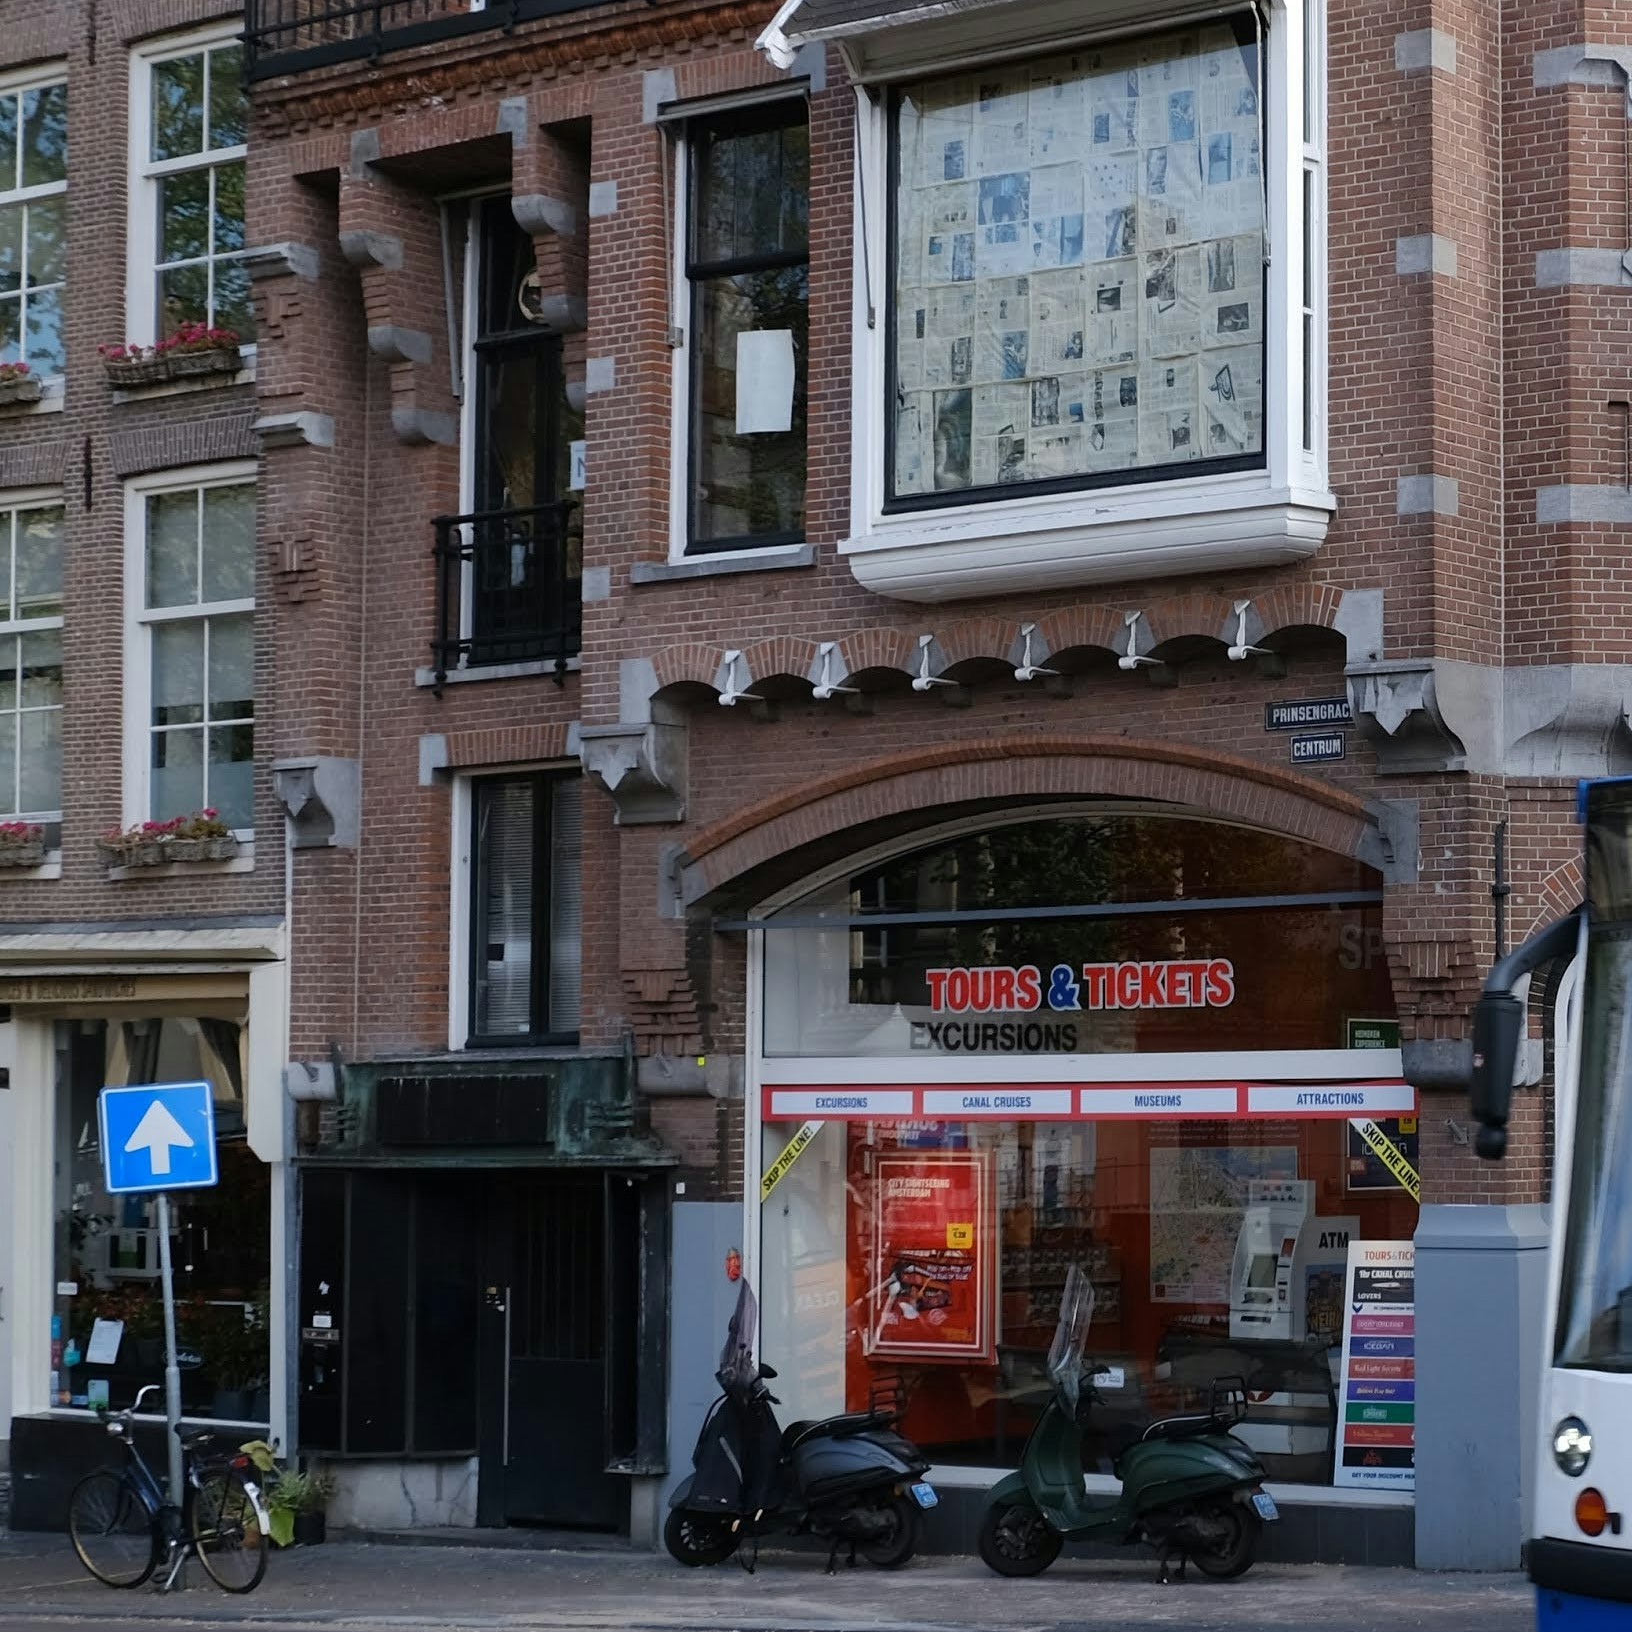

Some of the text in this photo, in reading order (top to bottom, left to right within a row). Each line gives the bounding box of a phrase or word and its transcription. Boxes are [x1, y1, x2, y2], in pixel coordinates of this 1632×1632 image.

[1293, 738, 1341, 757] CENTRUM
[926, 958, 1235, 1014] TOURS & TICKETS
[910, 1022, 1078, 1051] EXCURSIONS
[815, 1097, 868, 1109] EXCURSIONS
[962, 1096, 1031, 1108] CANAL CRUISES
[1134, 1095, 1181, 1107] MUSEUMS
[1296, 1092, 1364, 1106] ATTRACTIONS
[1362, 1123, 1385, 1147] SKIP
[1381, 1144, 1402, 1169] THE
[762, 1166, 780, 1191] SKIP
[777, 1149, 796, 1170] THE
[1318, 1231, 1349, 1249] ATM
[1365, 1251, 1391, 1260] TOURS
